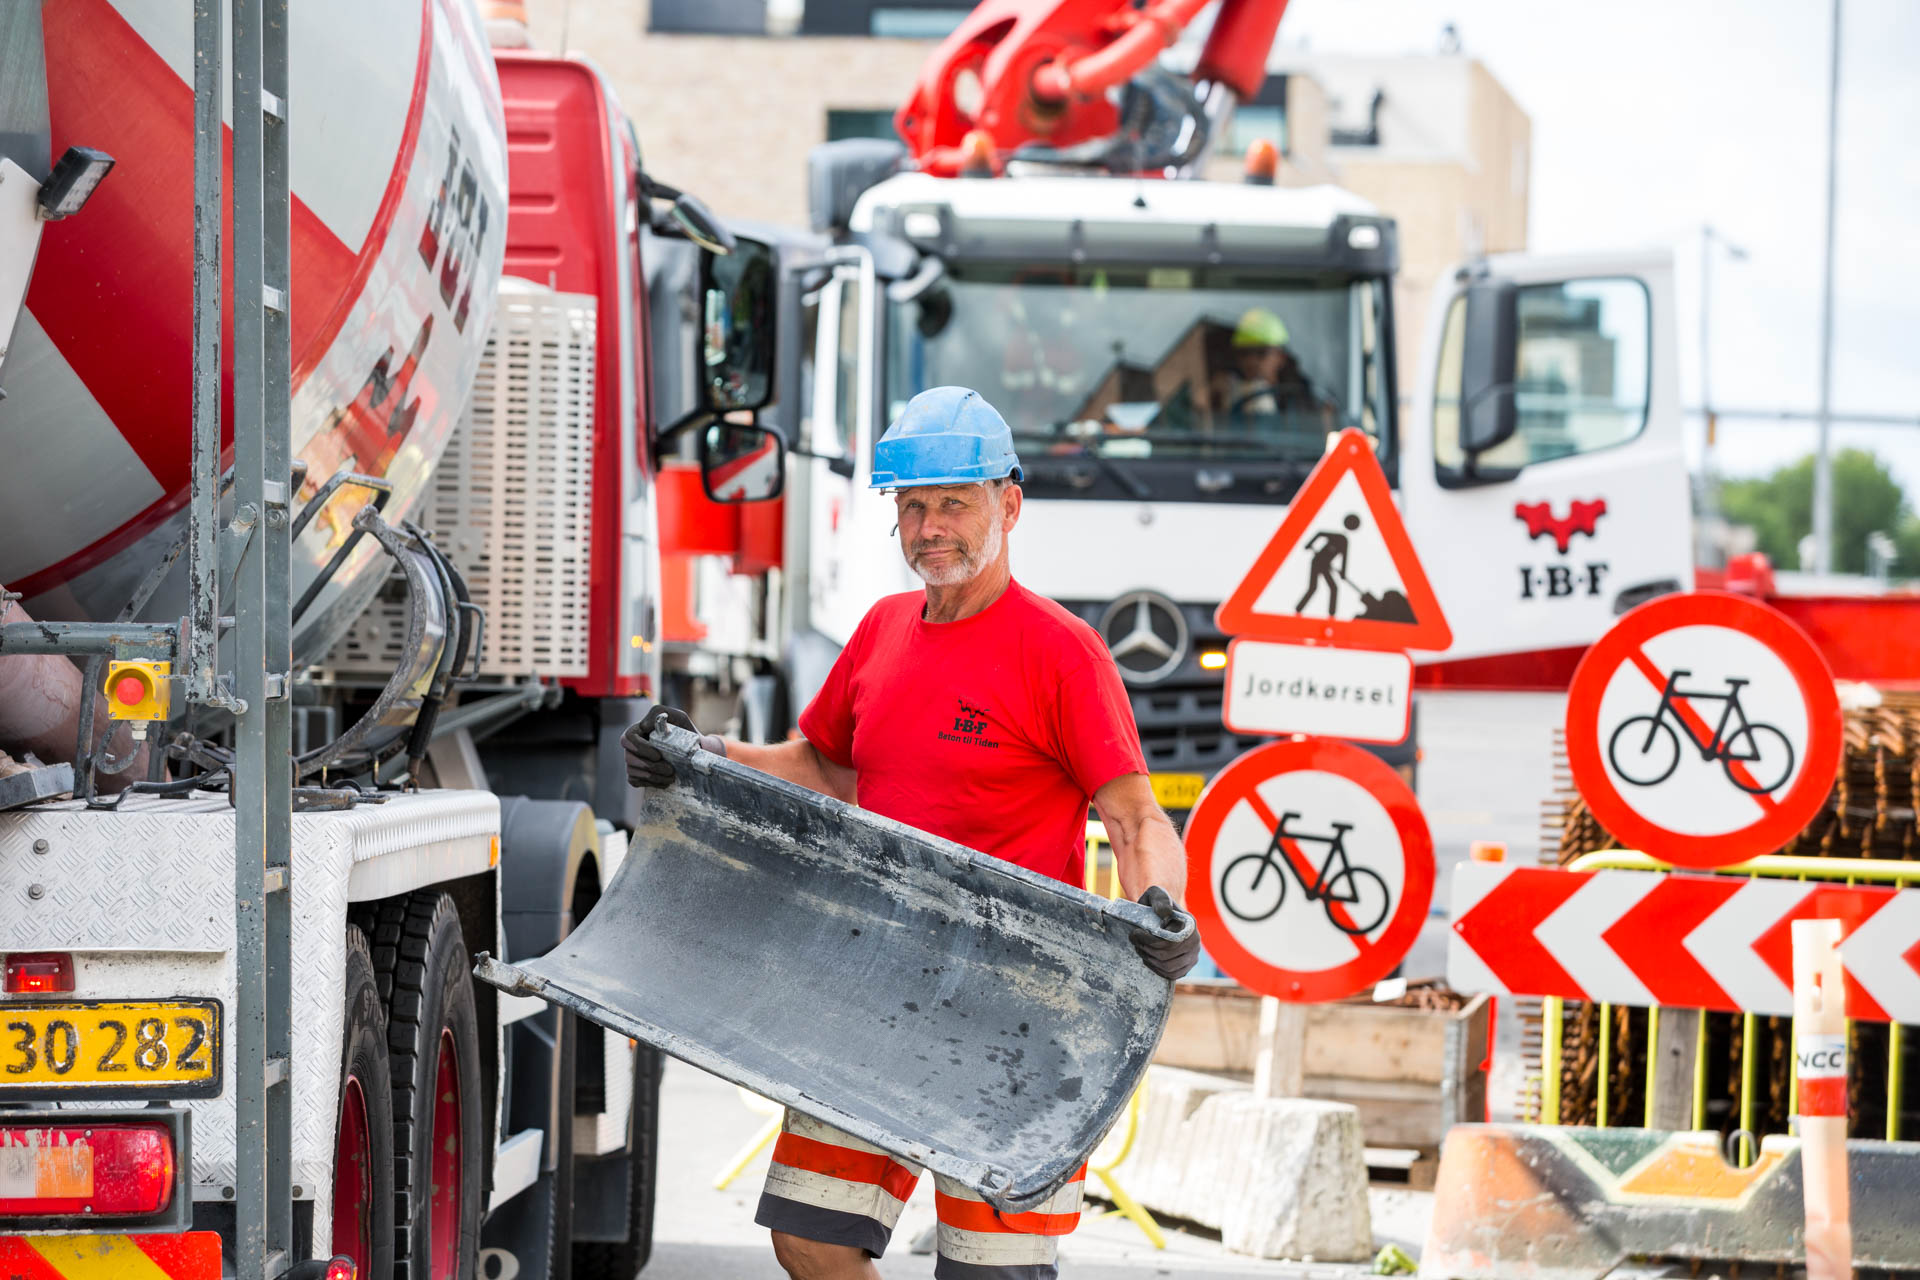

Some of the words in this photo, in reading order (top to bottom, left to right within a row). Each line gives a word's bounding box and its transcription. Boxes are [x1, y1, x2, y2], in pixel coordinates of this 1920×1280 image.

[1244, 674, 1394, 704] Jordkørsel
[938, 731, 961, 742] Beton
[963, 736, 972, 744] til
[974, 738, 999, 749] Tiden
[6, 1019, 79, 1075] 30
[96, 1017, 207, 1073] 282
[1796, 1051, 1842, 1068] NCC
